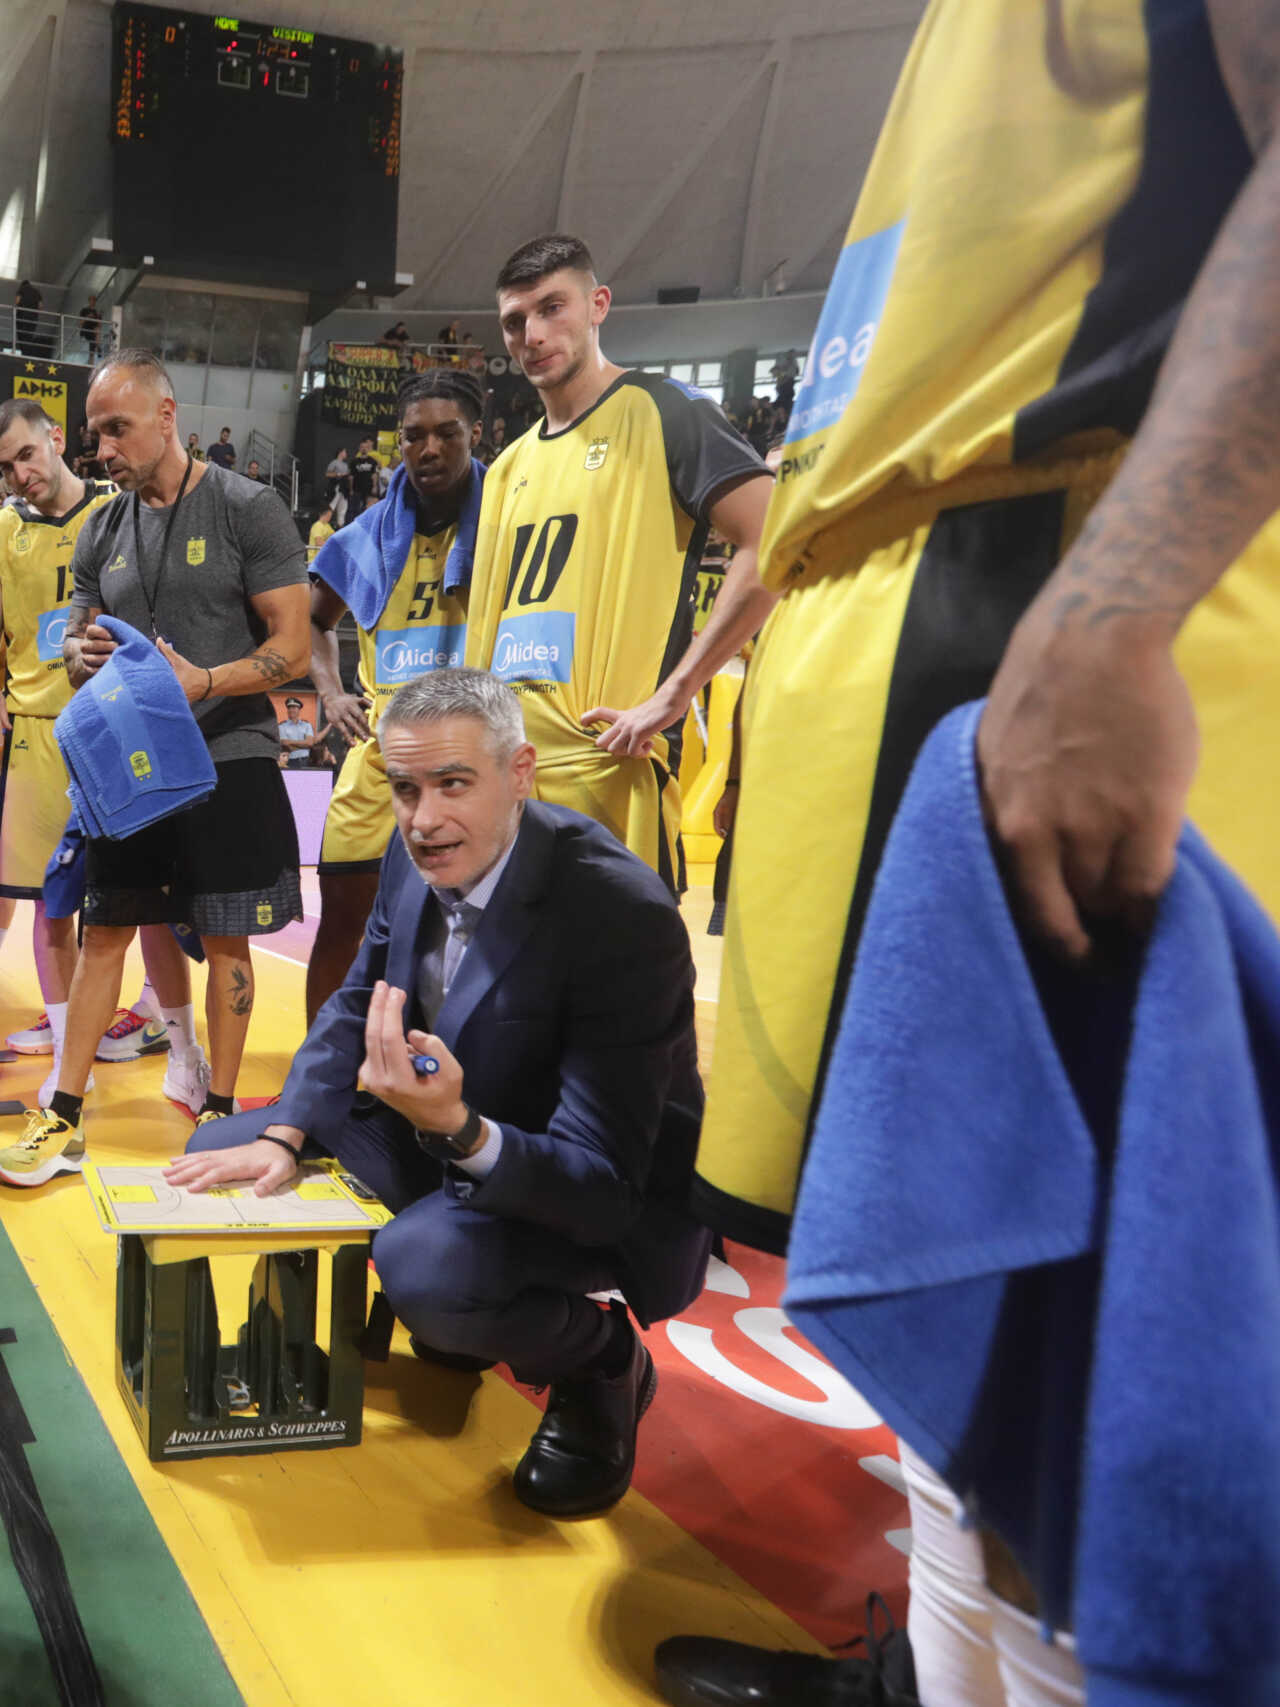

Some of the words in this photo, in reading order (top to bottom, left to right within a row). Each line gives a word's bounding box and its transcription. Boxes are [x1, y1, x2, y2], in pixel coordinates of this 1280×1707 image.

[214, 16, 239, 32] HOME
[272, 24, 315, 43] VISITOR
[503, 513, 579, 611] 10
[56, 565, 74, 602] 1
[407, 581, 440, 620] 5
[384, 642, 459, 672] Midea
[496, 635, 559, 671] Midea
[165, 1427, 256, 1445] APOLLINARIS
[257, 1427, 265, 1438] &
[268, 1420, 347, 1437] SCHWEPPES
